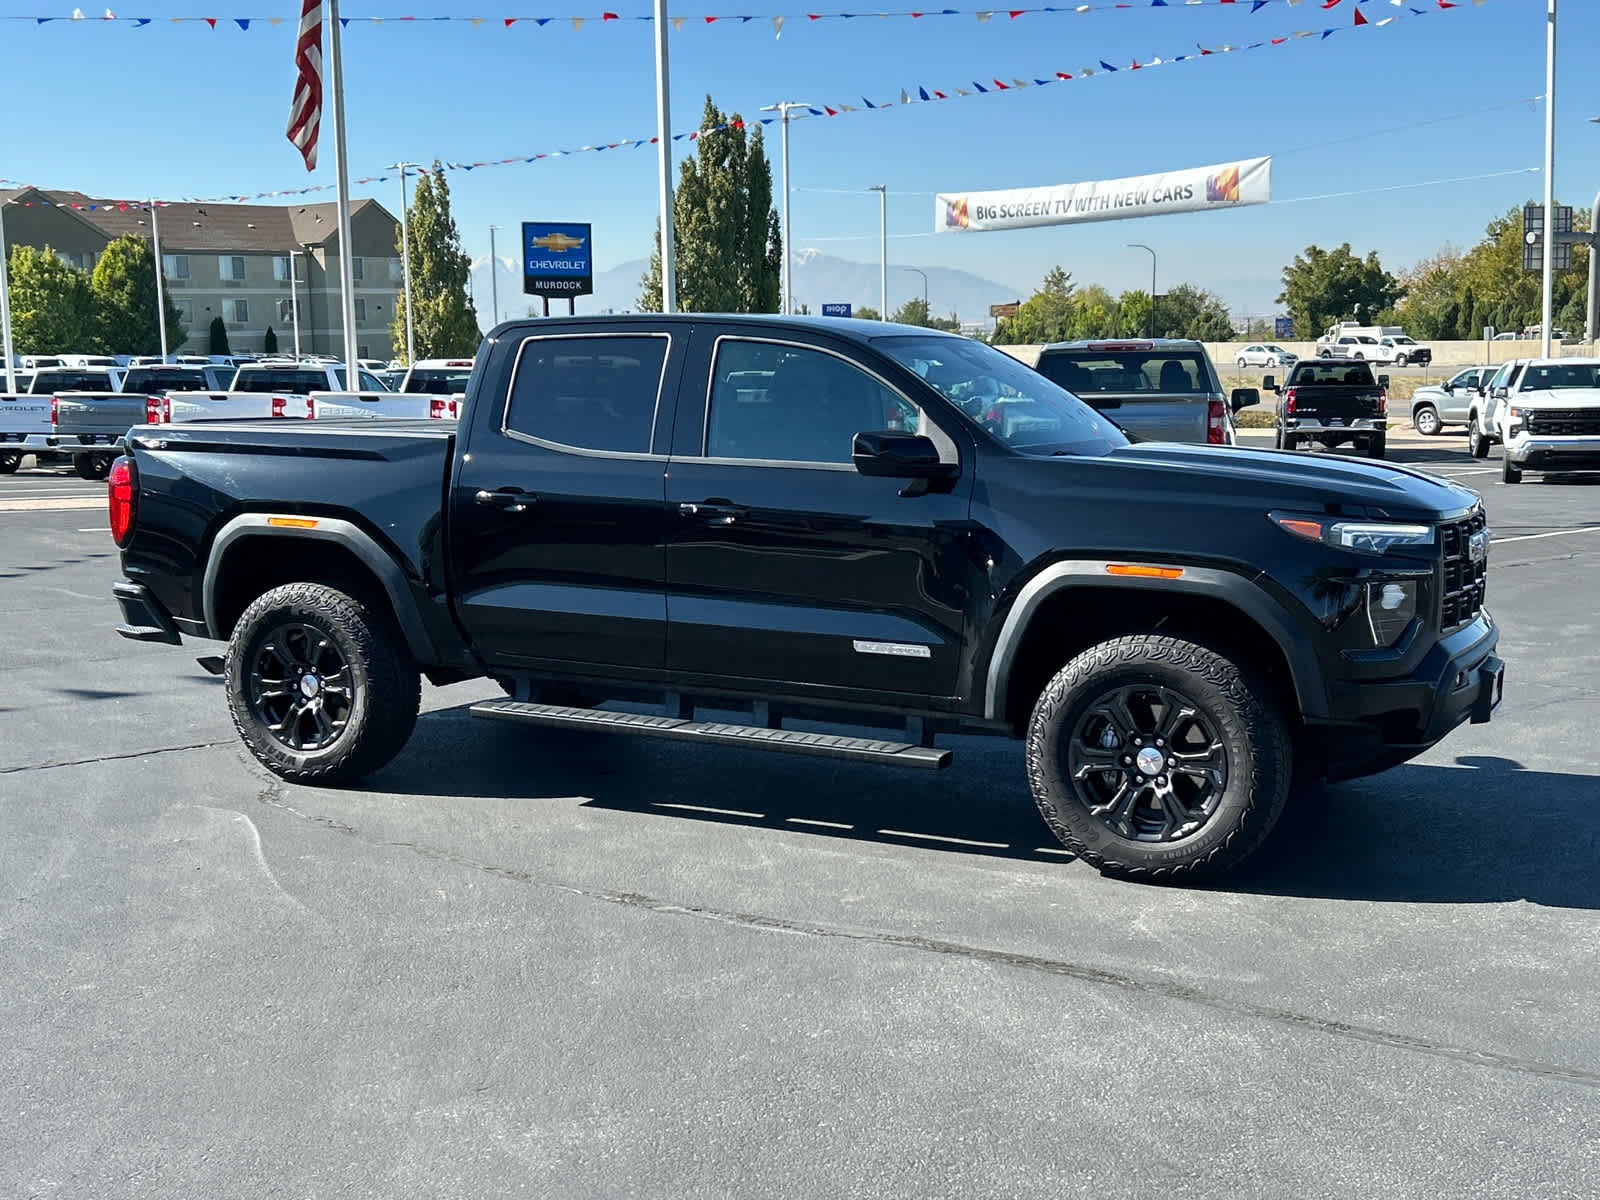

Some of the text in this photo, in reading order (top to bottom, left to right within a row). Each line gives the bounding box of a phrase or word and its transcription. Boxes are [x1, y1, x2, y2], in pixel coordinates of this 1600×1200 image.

[976, 184, 1193, 220] BIG SCREEN TV WITH NEW CARS
[529, 260, 586, 270] CHEVROLET
[535, 281, 582, 289] MURDOCK
